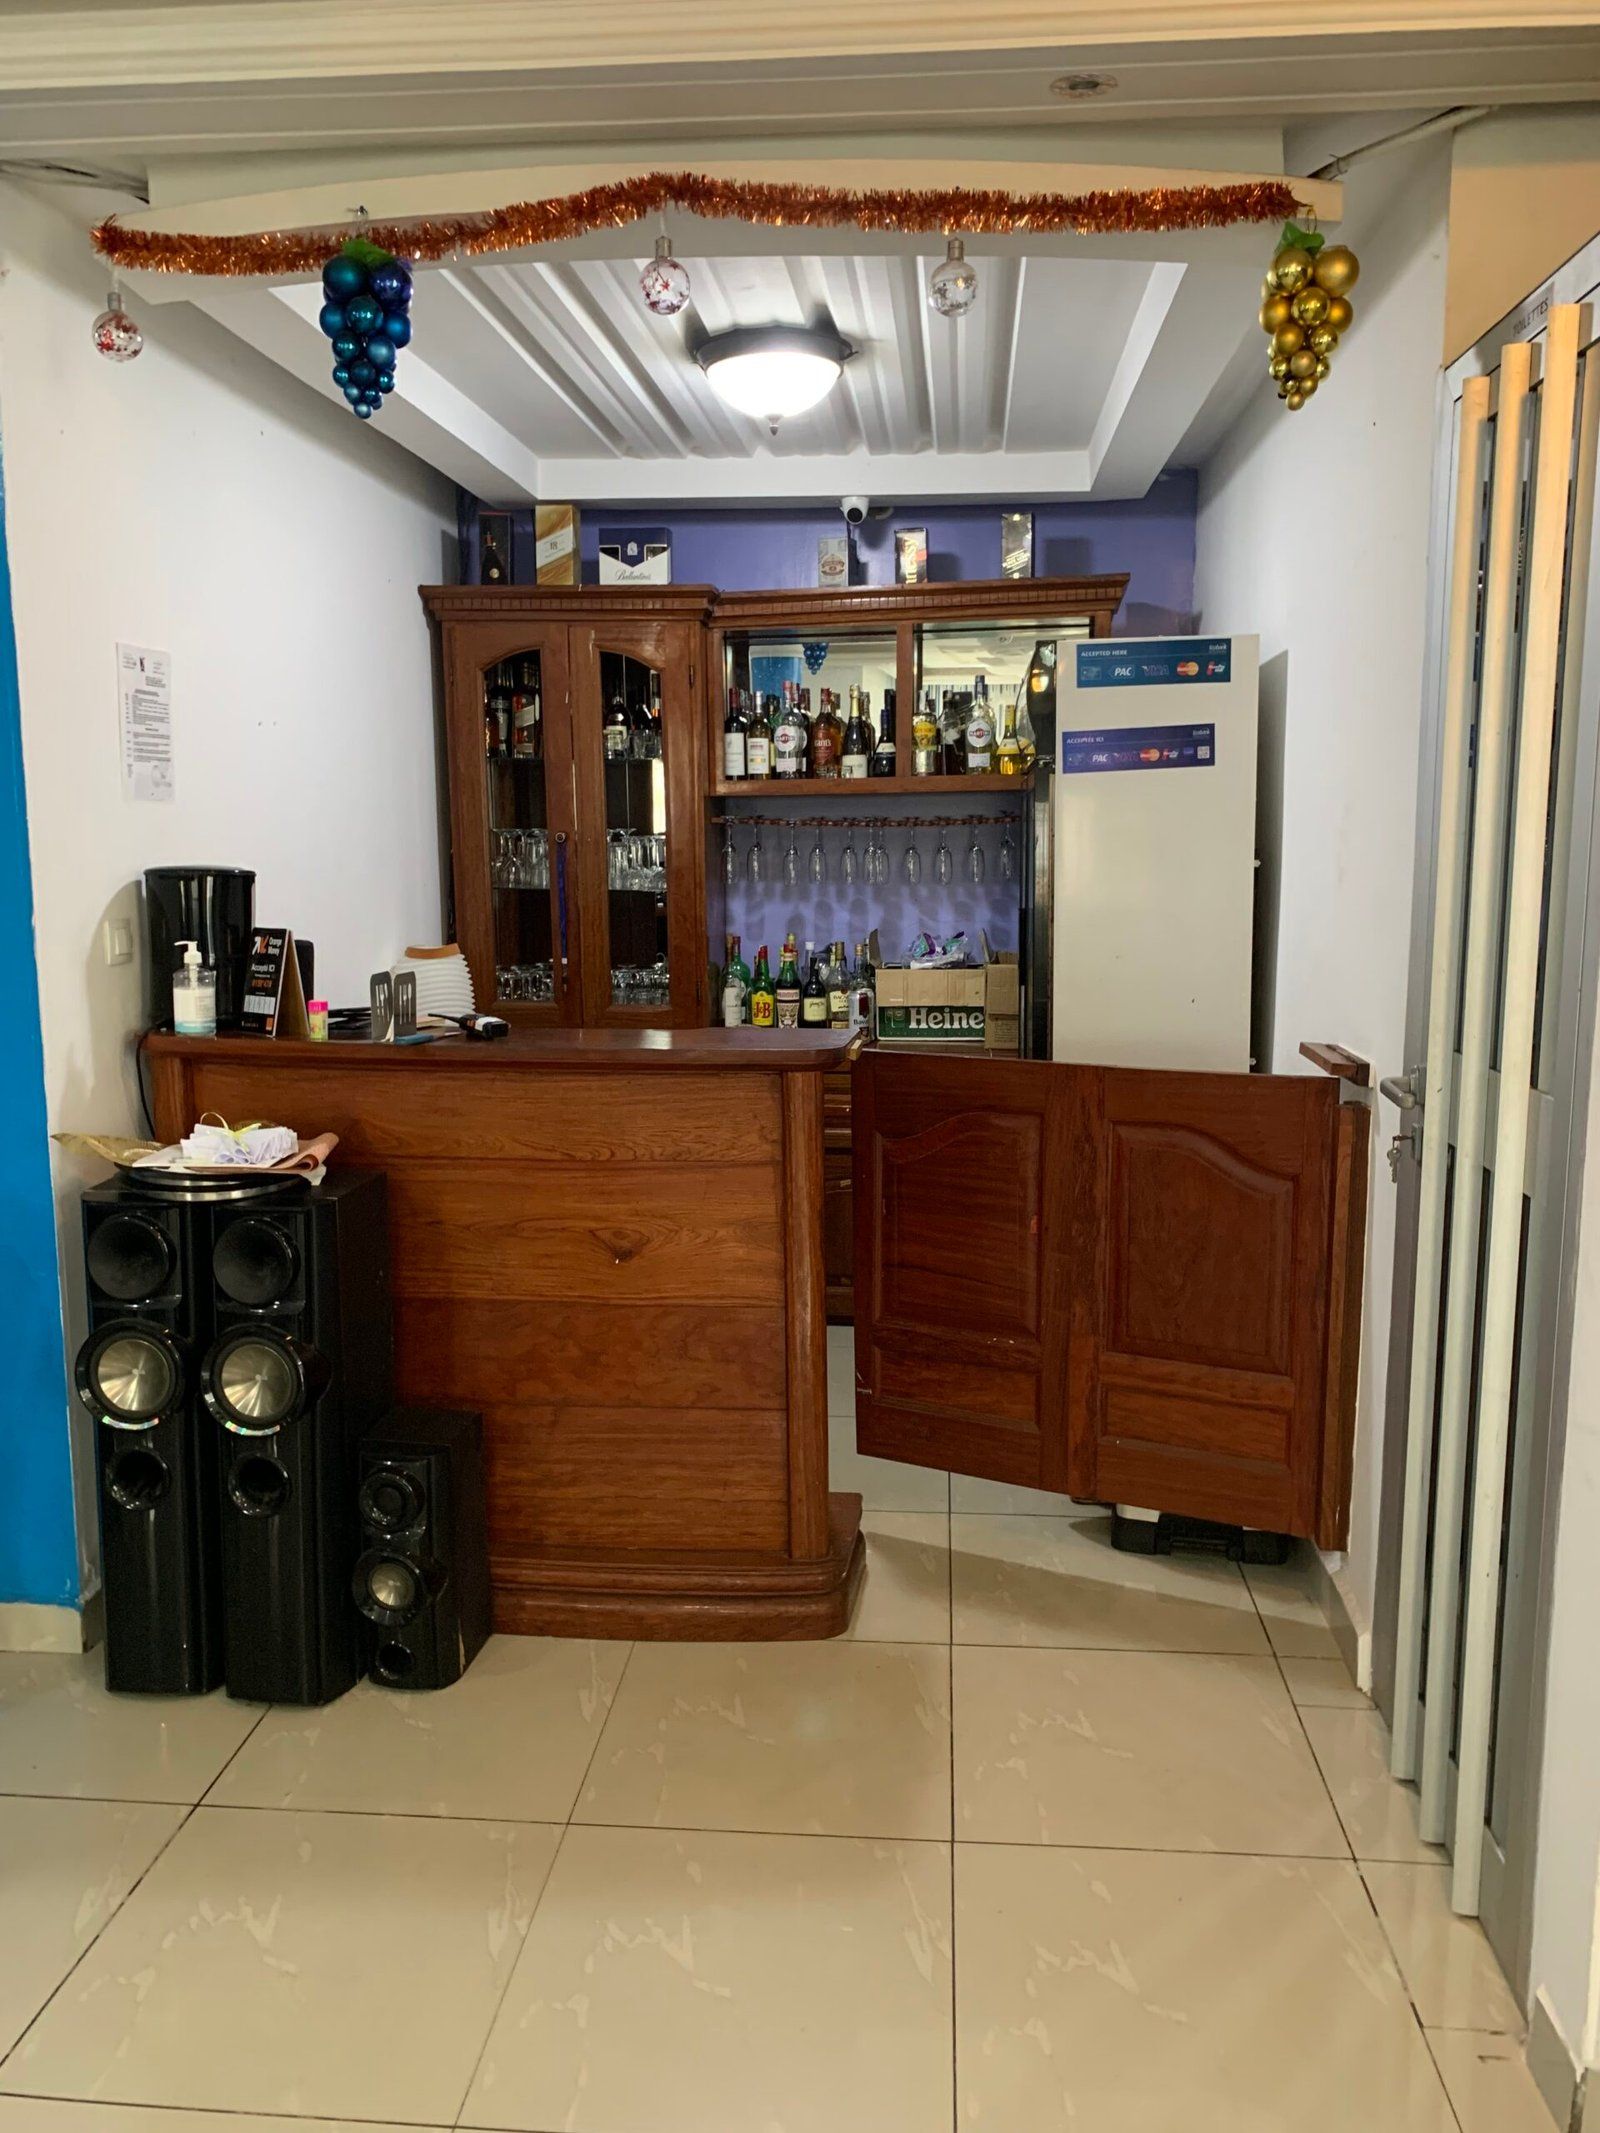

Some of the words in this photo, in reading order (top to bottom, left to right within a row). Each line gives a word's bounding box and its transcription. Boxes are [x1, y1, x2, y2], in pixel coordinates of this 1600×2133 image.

[1512, 297, 1549, 337] TOILETTES
[1114, 667, 1132, 676] PAC
[1092, 753, 1109, 762] PAC
[908, 1007, 985, 1030] Heine
